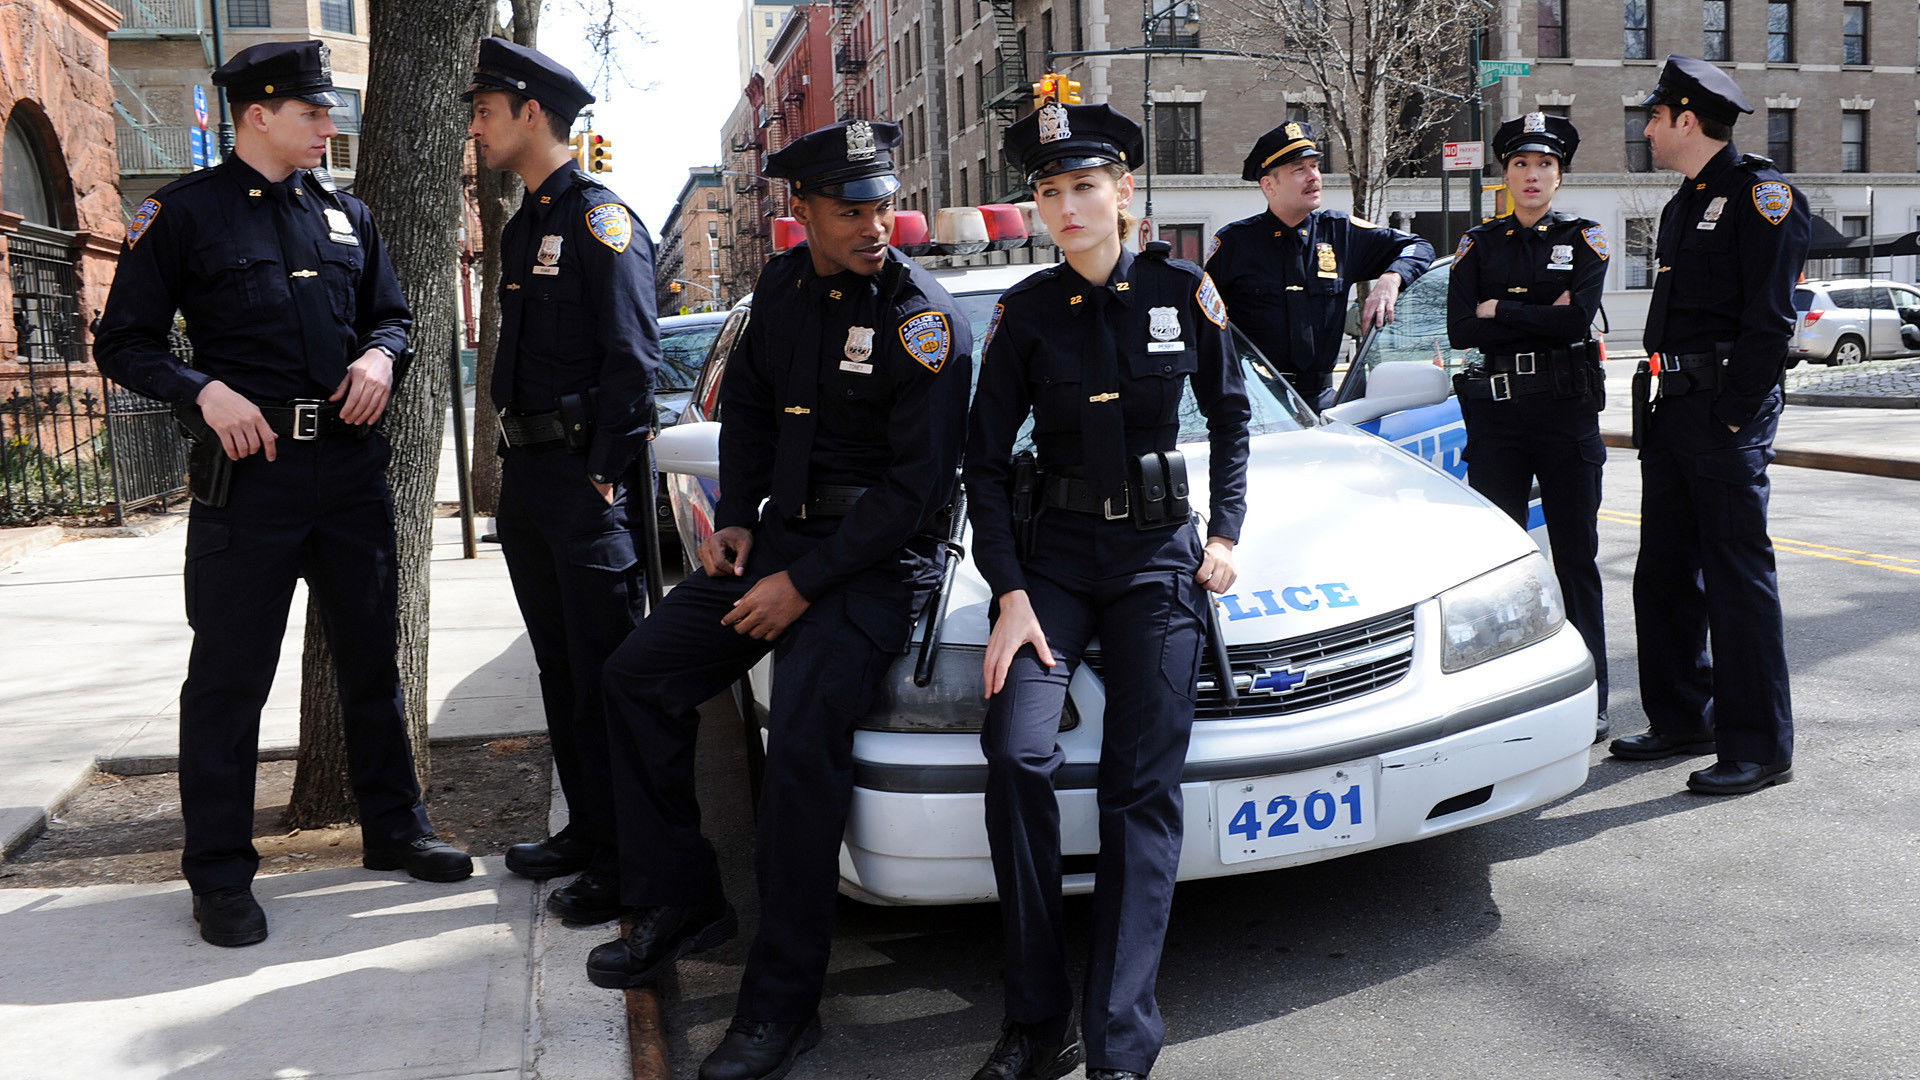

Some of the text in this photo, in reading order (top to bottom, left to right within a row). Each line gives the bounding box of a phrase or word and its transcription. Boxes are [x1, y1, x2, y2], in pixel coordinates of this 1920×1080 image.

[1445, 146, 1457, 155] NO
[1116, 282, 1129, 291] 22
[830, 290, 842, 299] 22
[1070, 295, 1082, 304] 22
[908, 315, 934, 328] POLICE
[903, 321, 943, 341] DEPARTMENT
[1216, 583, 1360, 621] LICE
[1228, 784, 1363, 841] 4201
